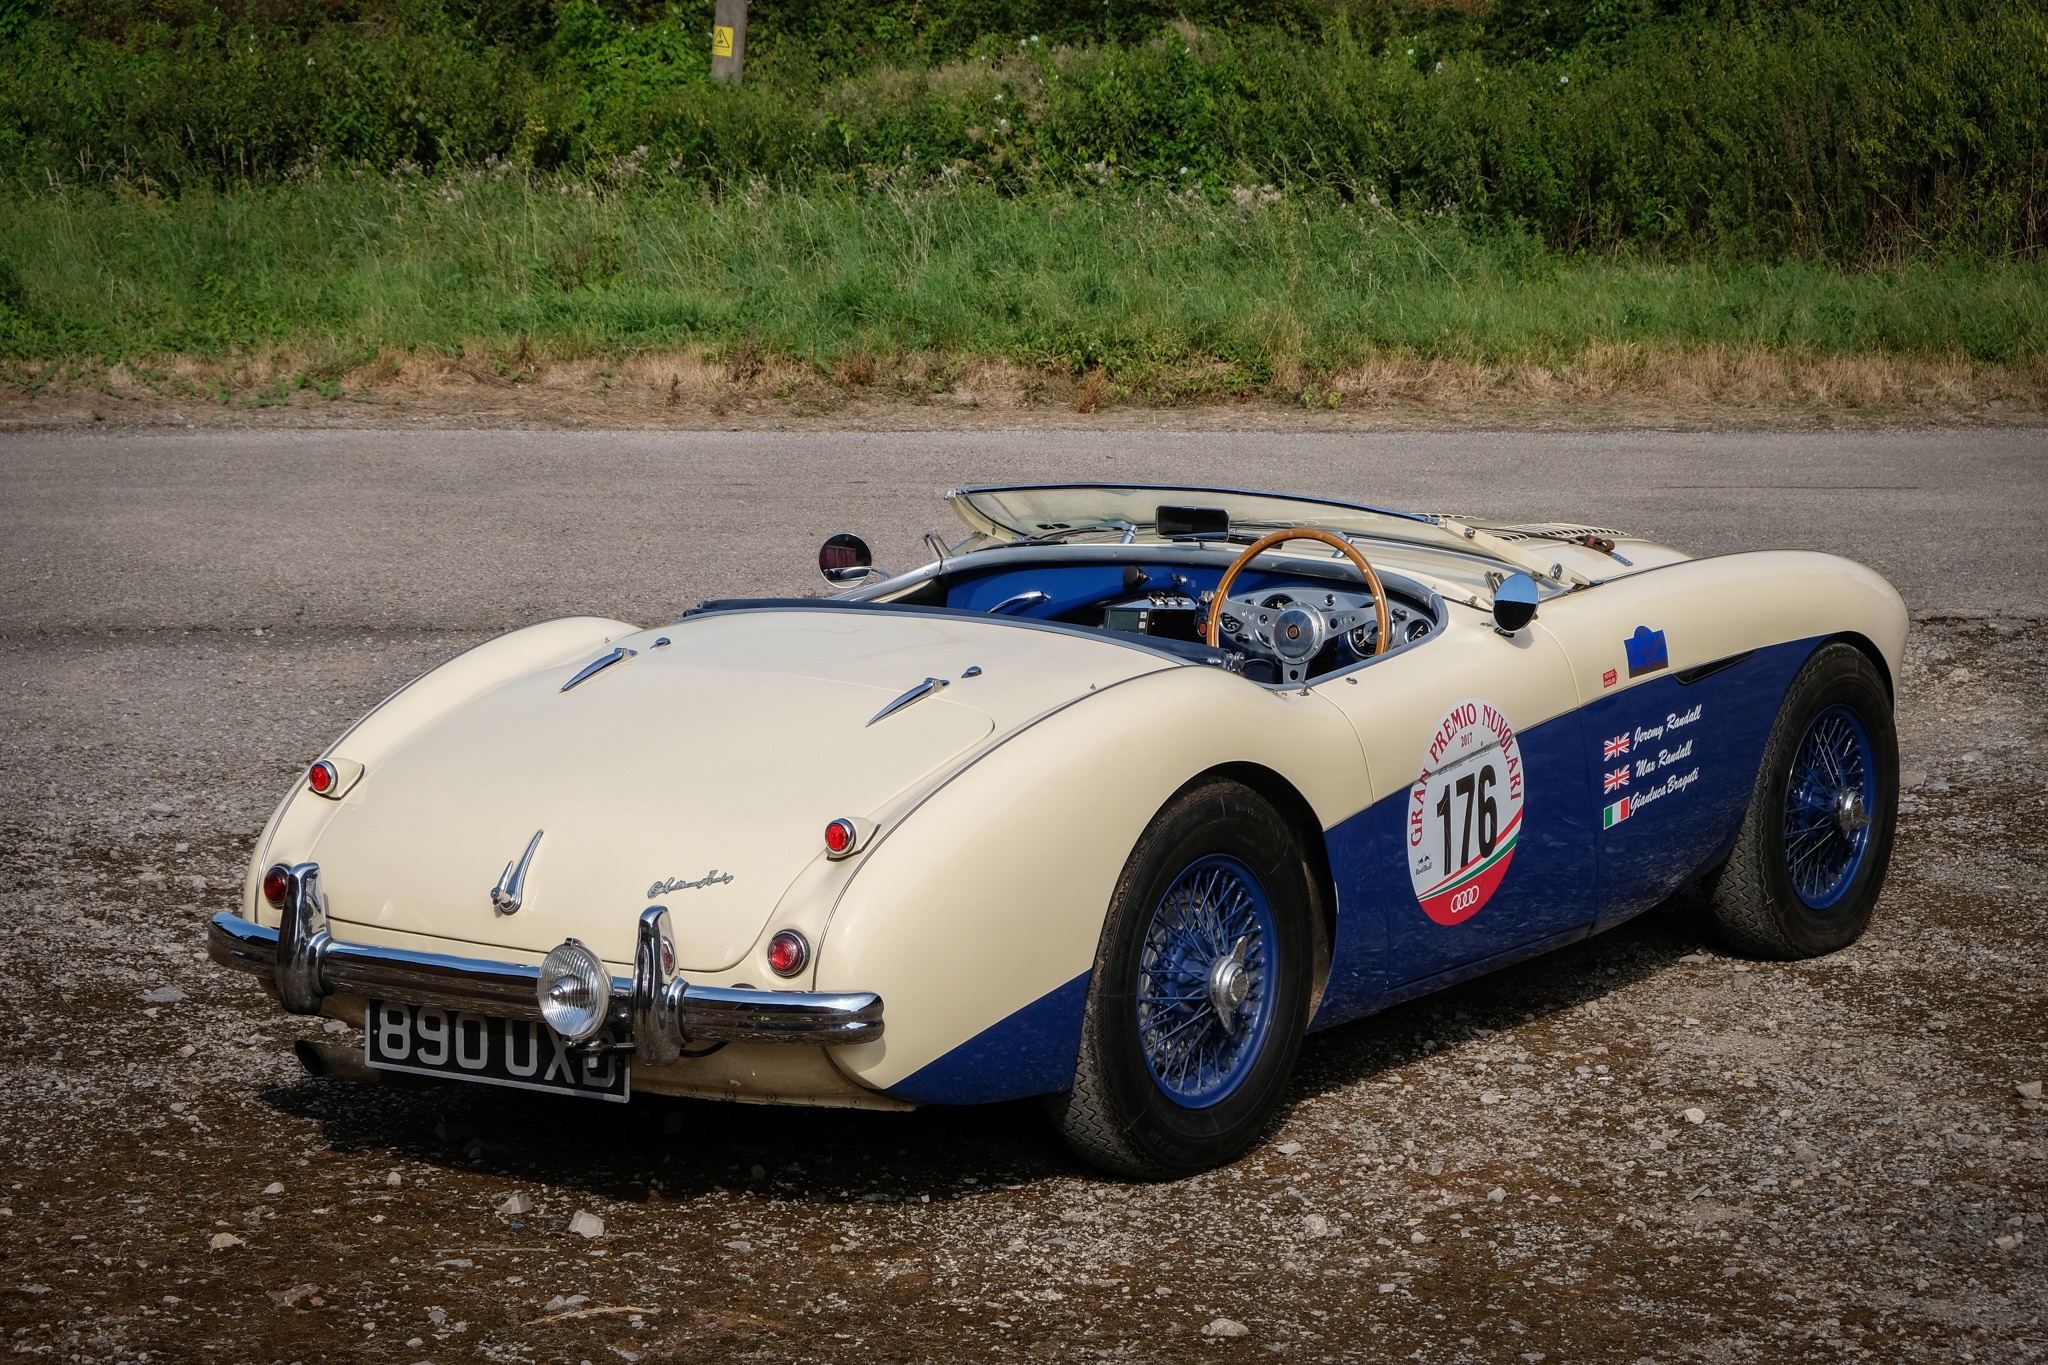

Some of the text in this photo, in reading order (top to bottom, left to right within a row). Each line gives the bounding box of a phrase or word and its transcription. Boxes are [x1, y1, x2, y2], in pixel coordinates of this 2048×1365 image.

[1461, 731, 1473, 747] 2017
[1633, 704, 1702, 751] Jeremy Randall
[1411, 702, 1522, 847] GRAN PREMIO NUVOLARI
[1636, 739, 1693, 778] Max Randall
[1436, 764, 1497, 876] 176
[1630, 785, 1667, 817] Gianluca
[379, 1001, 488, 1070] 890
